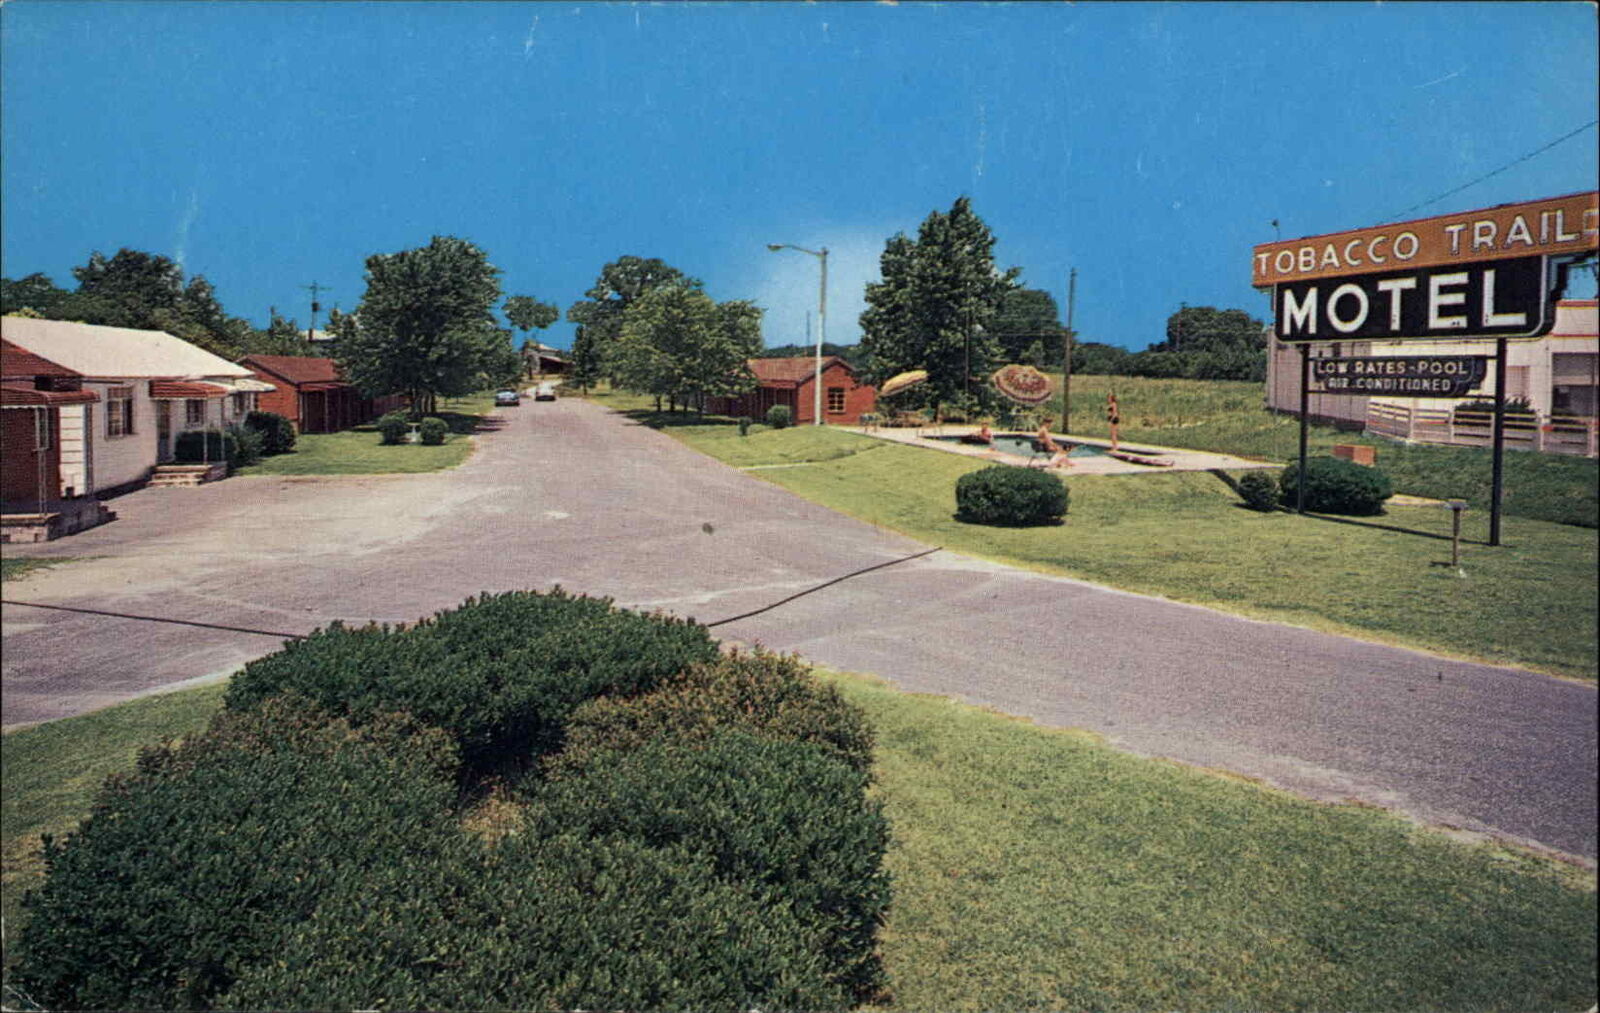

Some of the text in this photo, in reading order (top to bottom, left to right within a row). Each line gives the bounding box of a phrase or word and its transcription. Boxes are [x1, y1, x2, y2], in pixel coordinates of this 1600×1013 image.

[1257, 209, 1579, 276] TOBACCO TRAIL
[1283, 269, 1527, 335] MOTEL
[1317, 361, 1347, 374] LOW
[1328, 378, 1451, 391] AIR CONDITIONED
